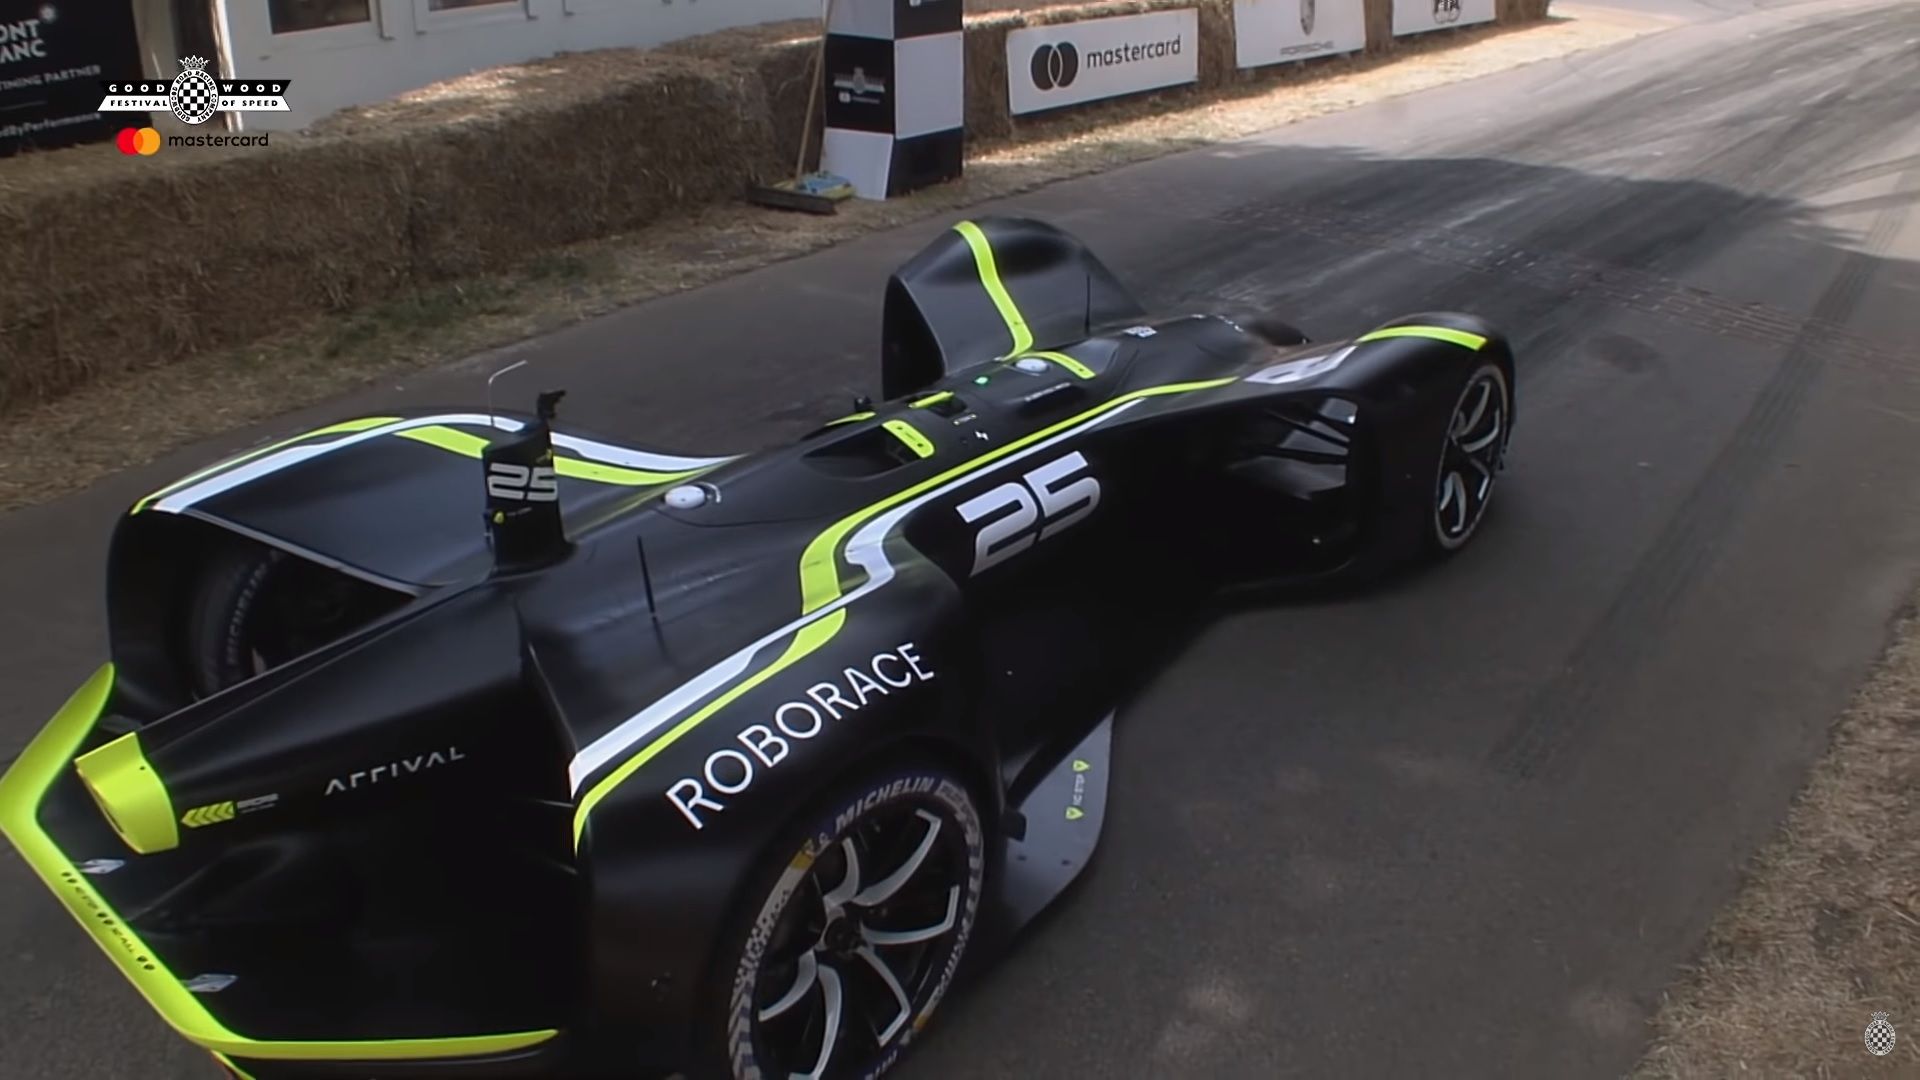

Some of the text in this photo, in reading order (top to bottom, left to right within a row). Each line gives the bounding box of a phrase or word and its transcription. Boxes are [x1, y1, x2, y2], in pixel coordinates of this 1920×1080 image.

[1087, 35, 1181, 69] mastercard
[487, 462, 558, 502] 25
[955, 450, 1100, 578] 25
[665, 642, 934, 830] ROBORACE
[835, 776, 934, 834] MICHELIN
